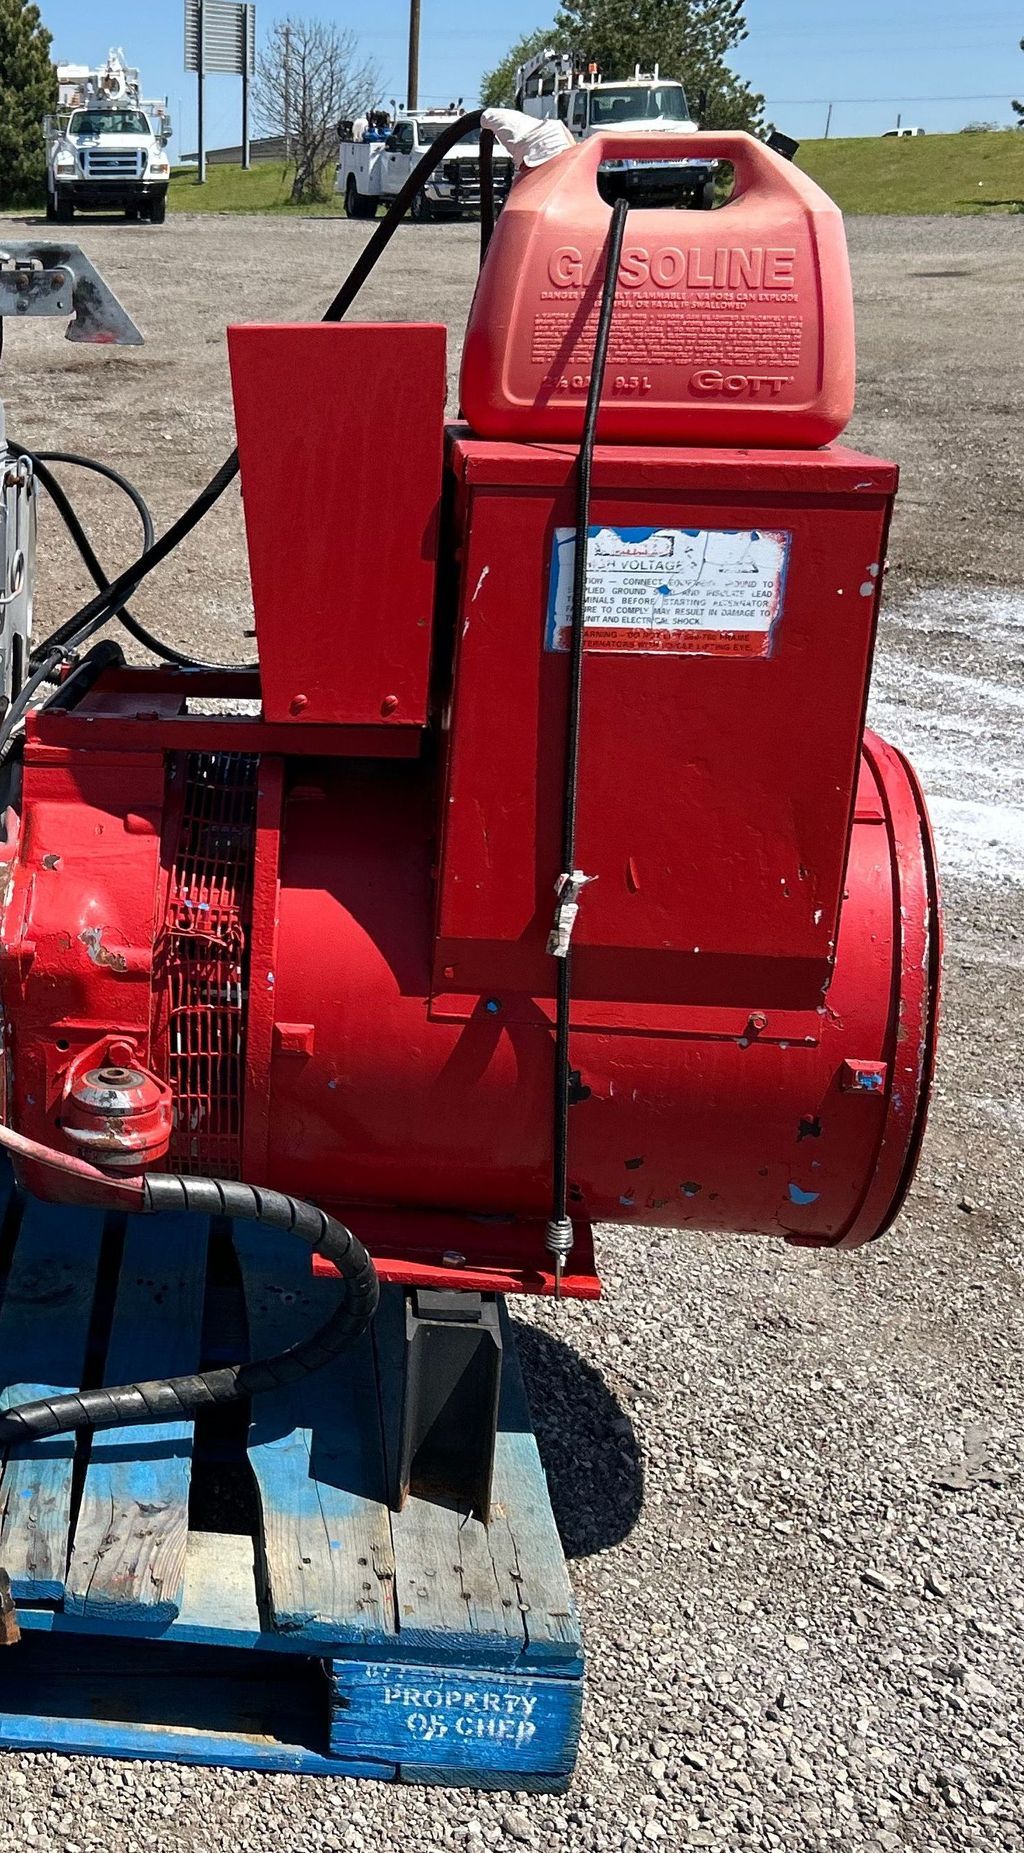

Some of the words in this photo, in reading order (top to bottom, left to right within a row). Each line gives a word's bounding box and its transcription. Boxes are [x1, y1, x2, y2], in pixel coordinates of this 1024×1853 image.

[632, 291, 687, 301] FLAMMABLE
[696, 292, 733, 302] VAPORS
[736, 292, 756, 302] CAN
[758, 293, 799, 303] EXPLODE
[636, 301, 649, 309] OR
[651, 301, 679, 310] FATAL
[690, 302, 747, 311] SWALLOWED
[622, 577, 663, 587] CONNECT
[762, 581, 774, 589] TO
[611, 587, 647, 596] GROUND
[751, 590, 773, 598] LEAD
[621, 597, 656, 606] BEFORE
[663, 599, 707, 608] STARTING
[601, 606, 613, 614] TO
[615, 606, 650, 615] COMPLY
[653, 608, 671, 616] MAY
[674, 608, 705, 617] RESULT
[708, 609, 718, 617] IN
[720, 609, 756, 617] DAMAGE
[602, 616, 620, 624] AND
[384, 1686, 538, 1715] PROPERTY
